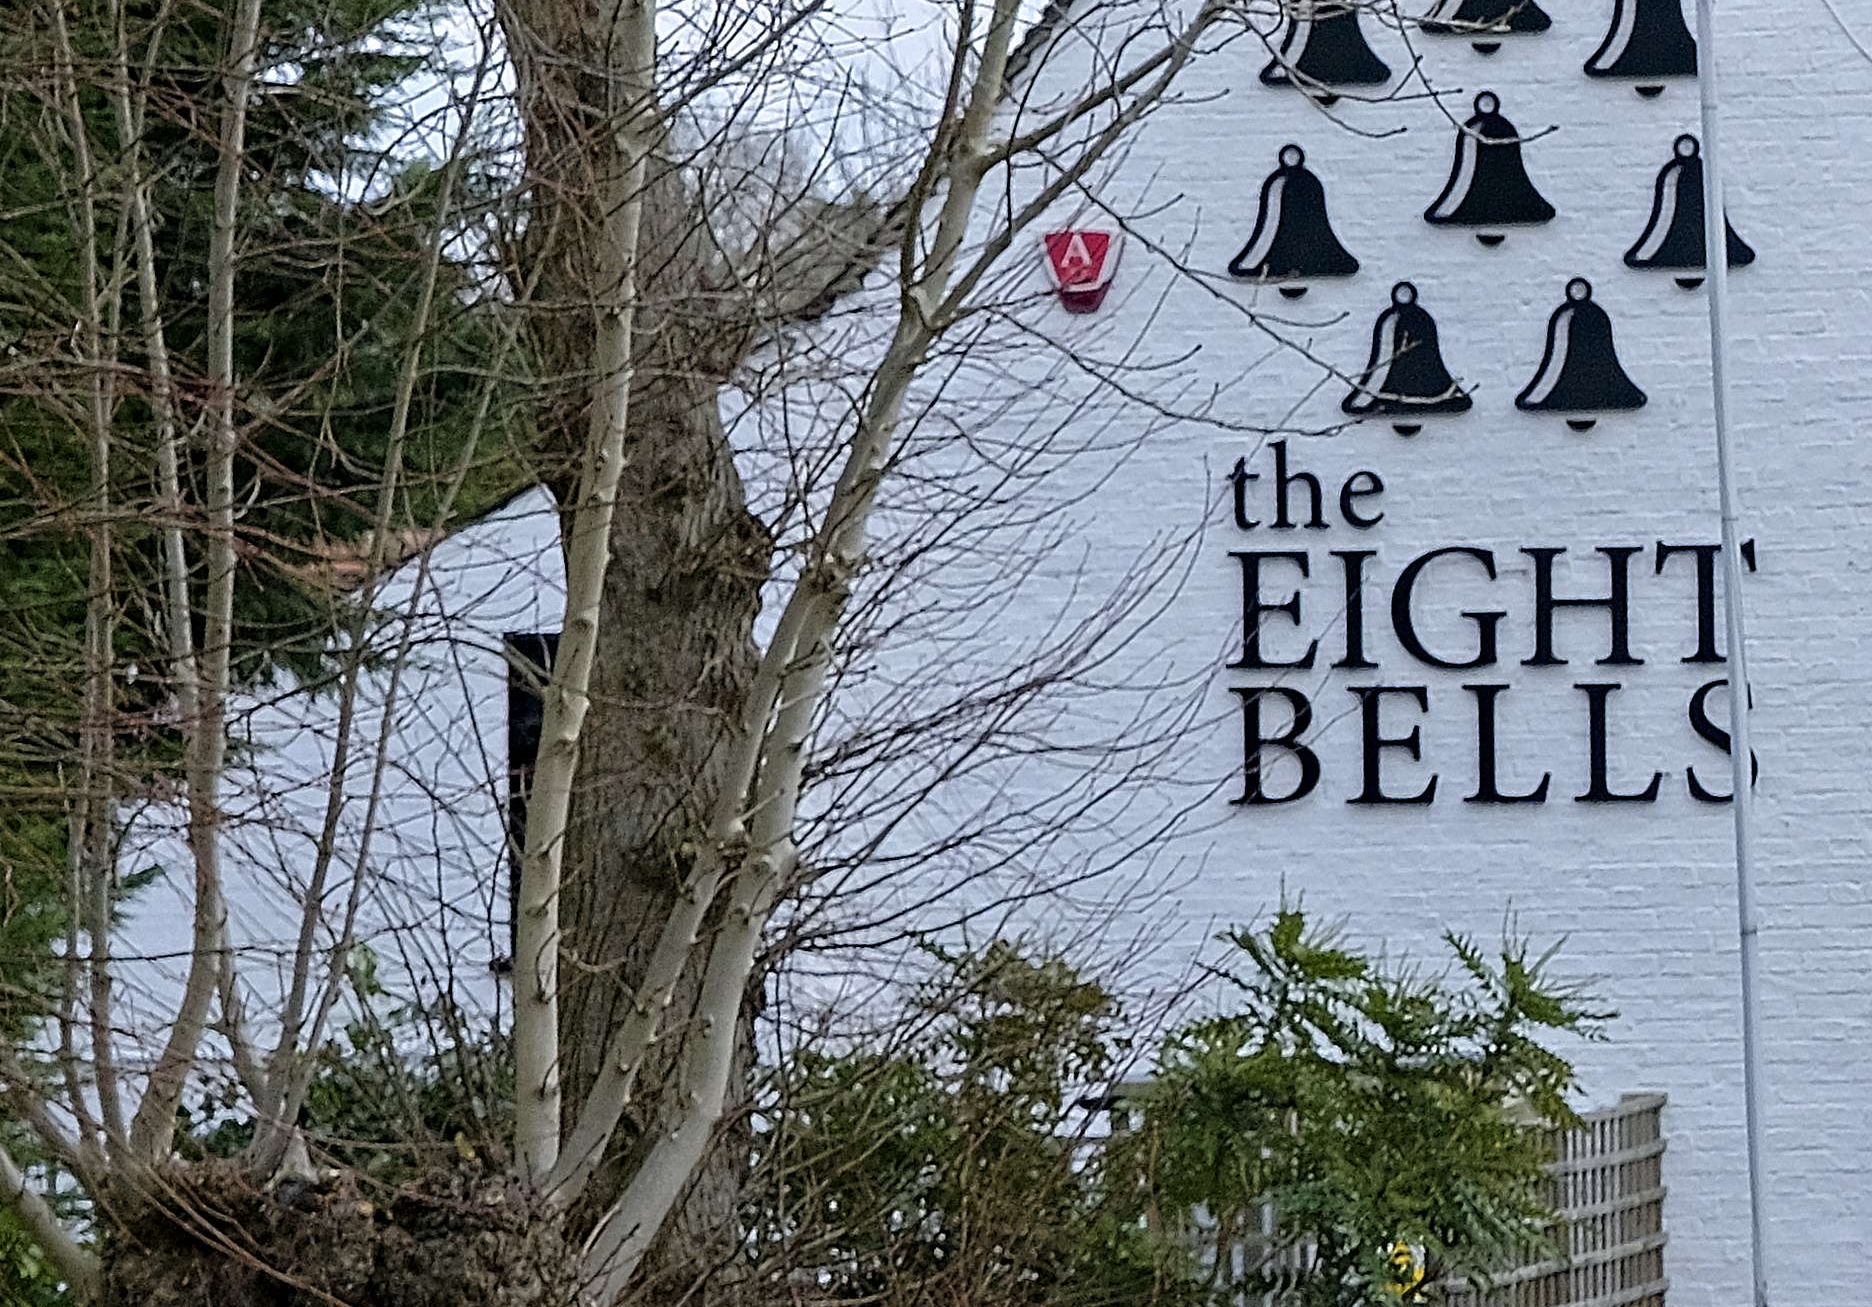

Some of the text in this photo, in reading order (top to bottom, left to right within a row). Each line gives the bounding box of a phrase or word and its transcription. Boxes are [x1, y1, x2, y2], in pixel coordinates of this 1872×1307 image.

[1228, 440, 1385, 529] the
[1226, 539, 1757, 669] EIGHT
[1228, 679, 1758, 804] BELLS
